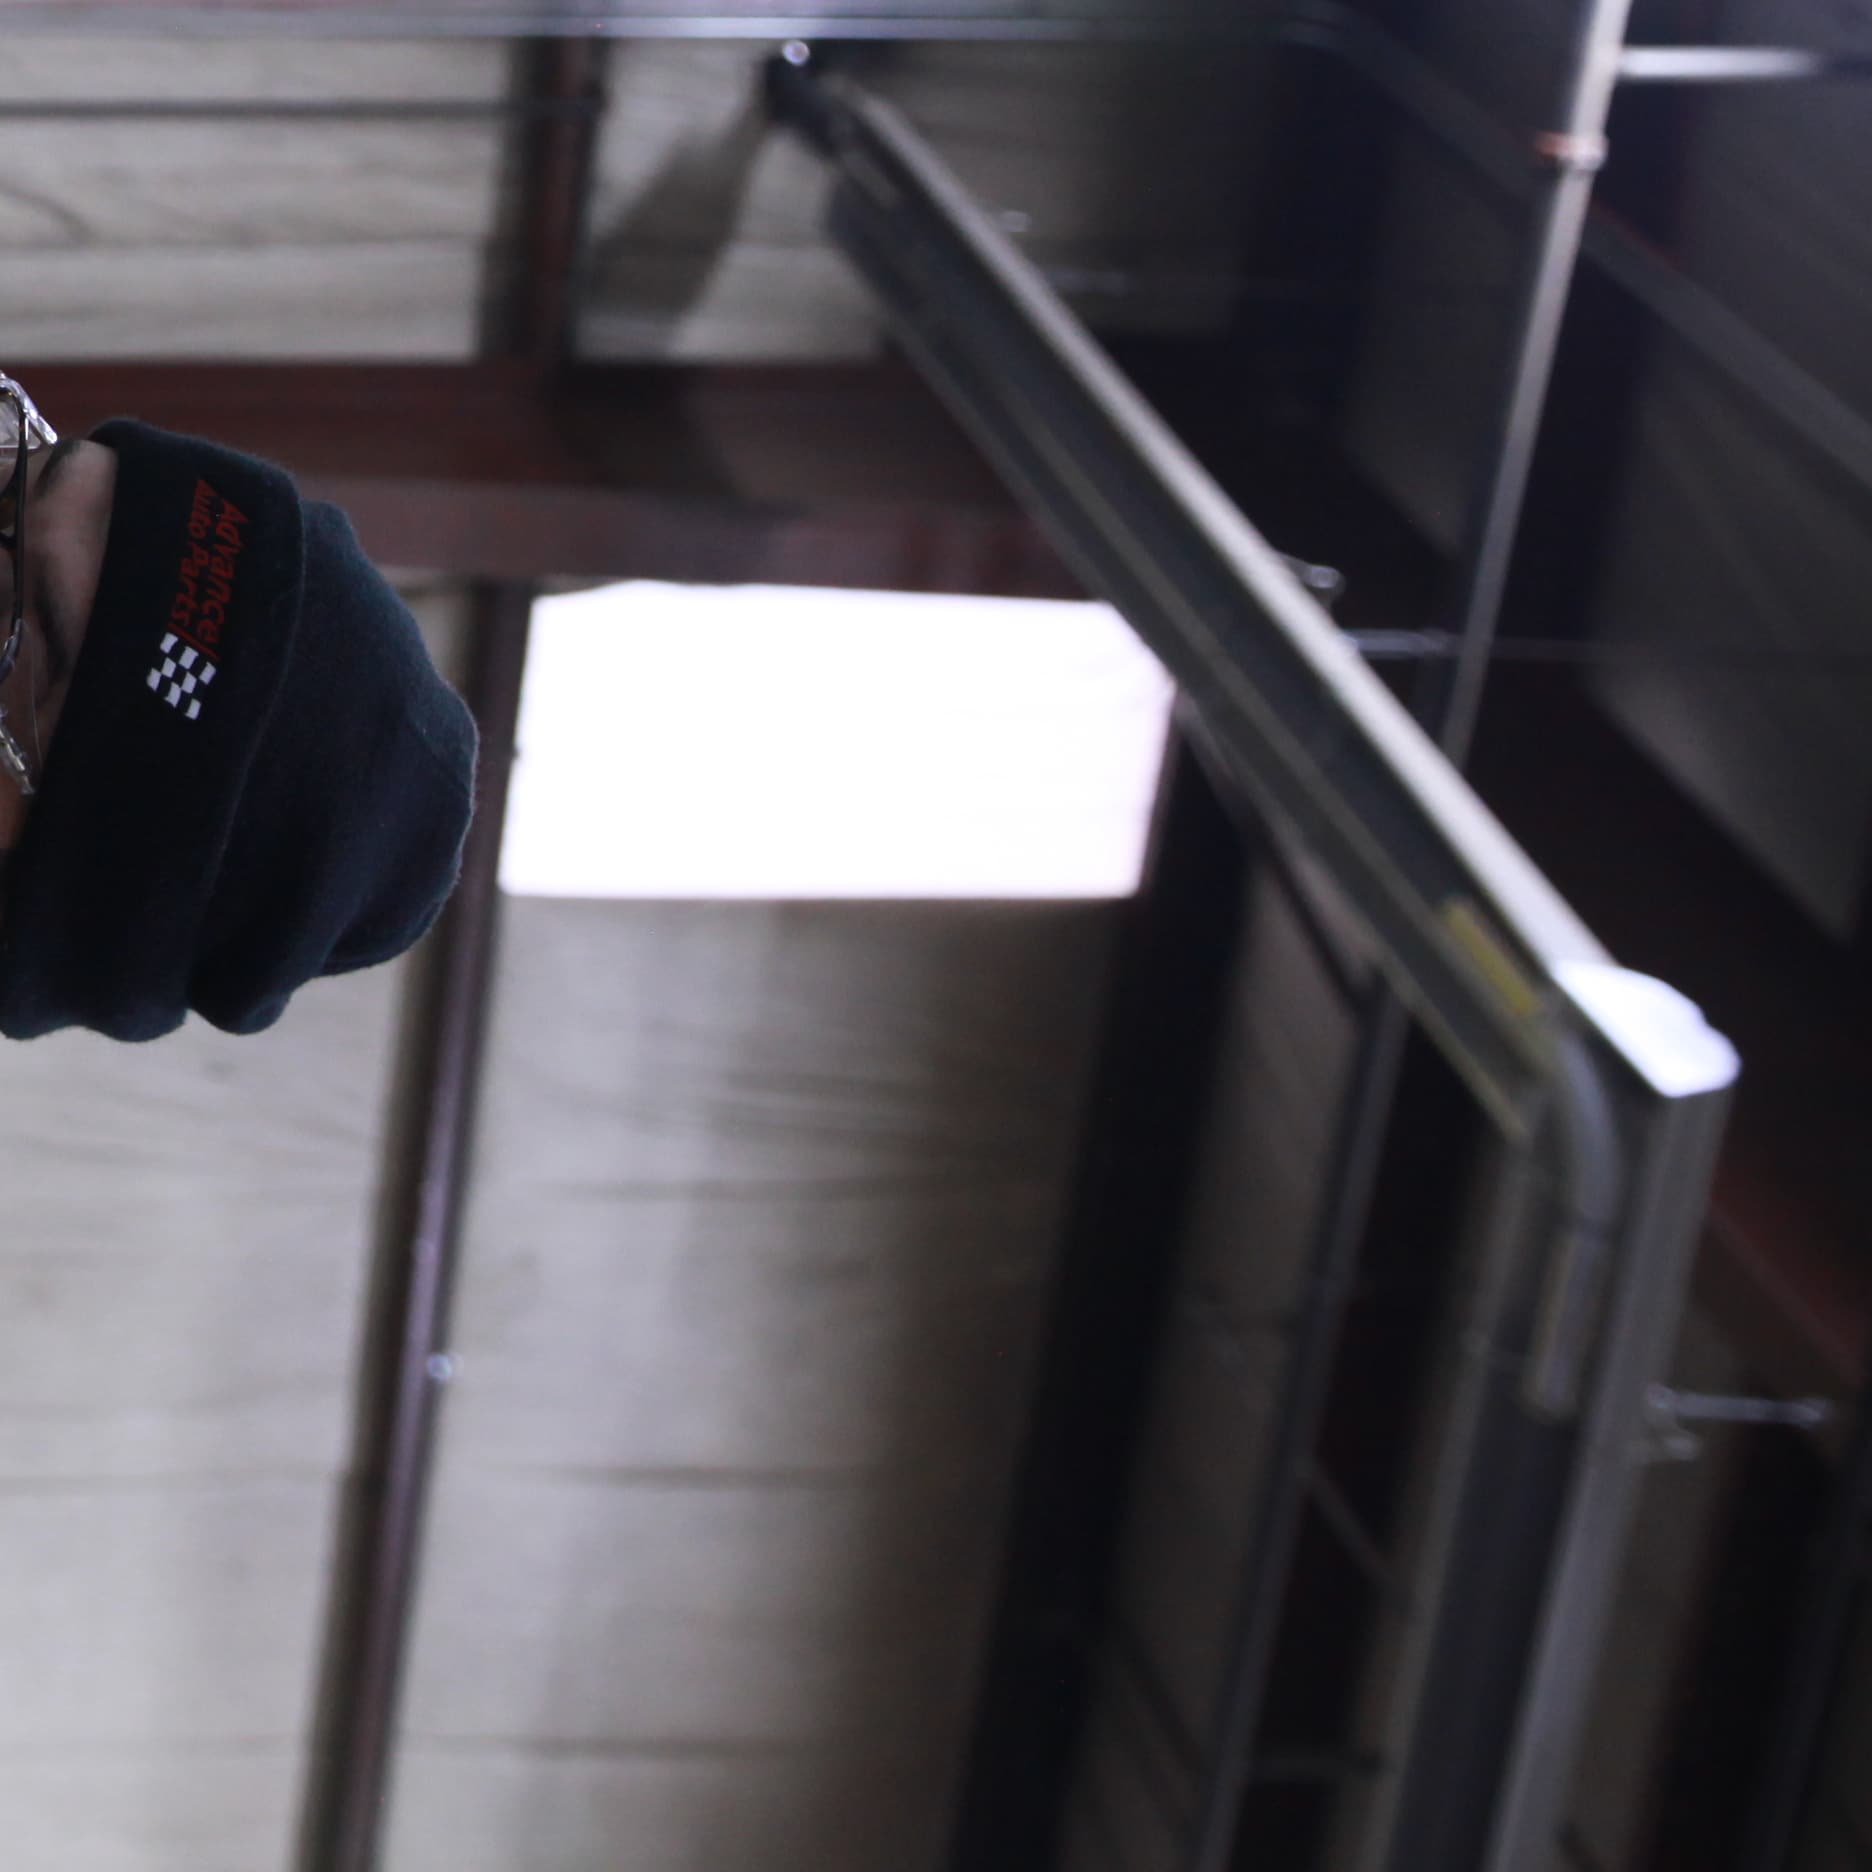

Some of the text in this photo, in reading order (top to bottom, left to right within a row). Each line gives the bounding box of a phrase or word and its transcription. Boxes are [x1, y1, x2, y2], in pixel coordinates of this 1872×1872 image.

[171, 478, 220, 627] Auto Parts
[197, 497, 250, 645] Advance
